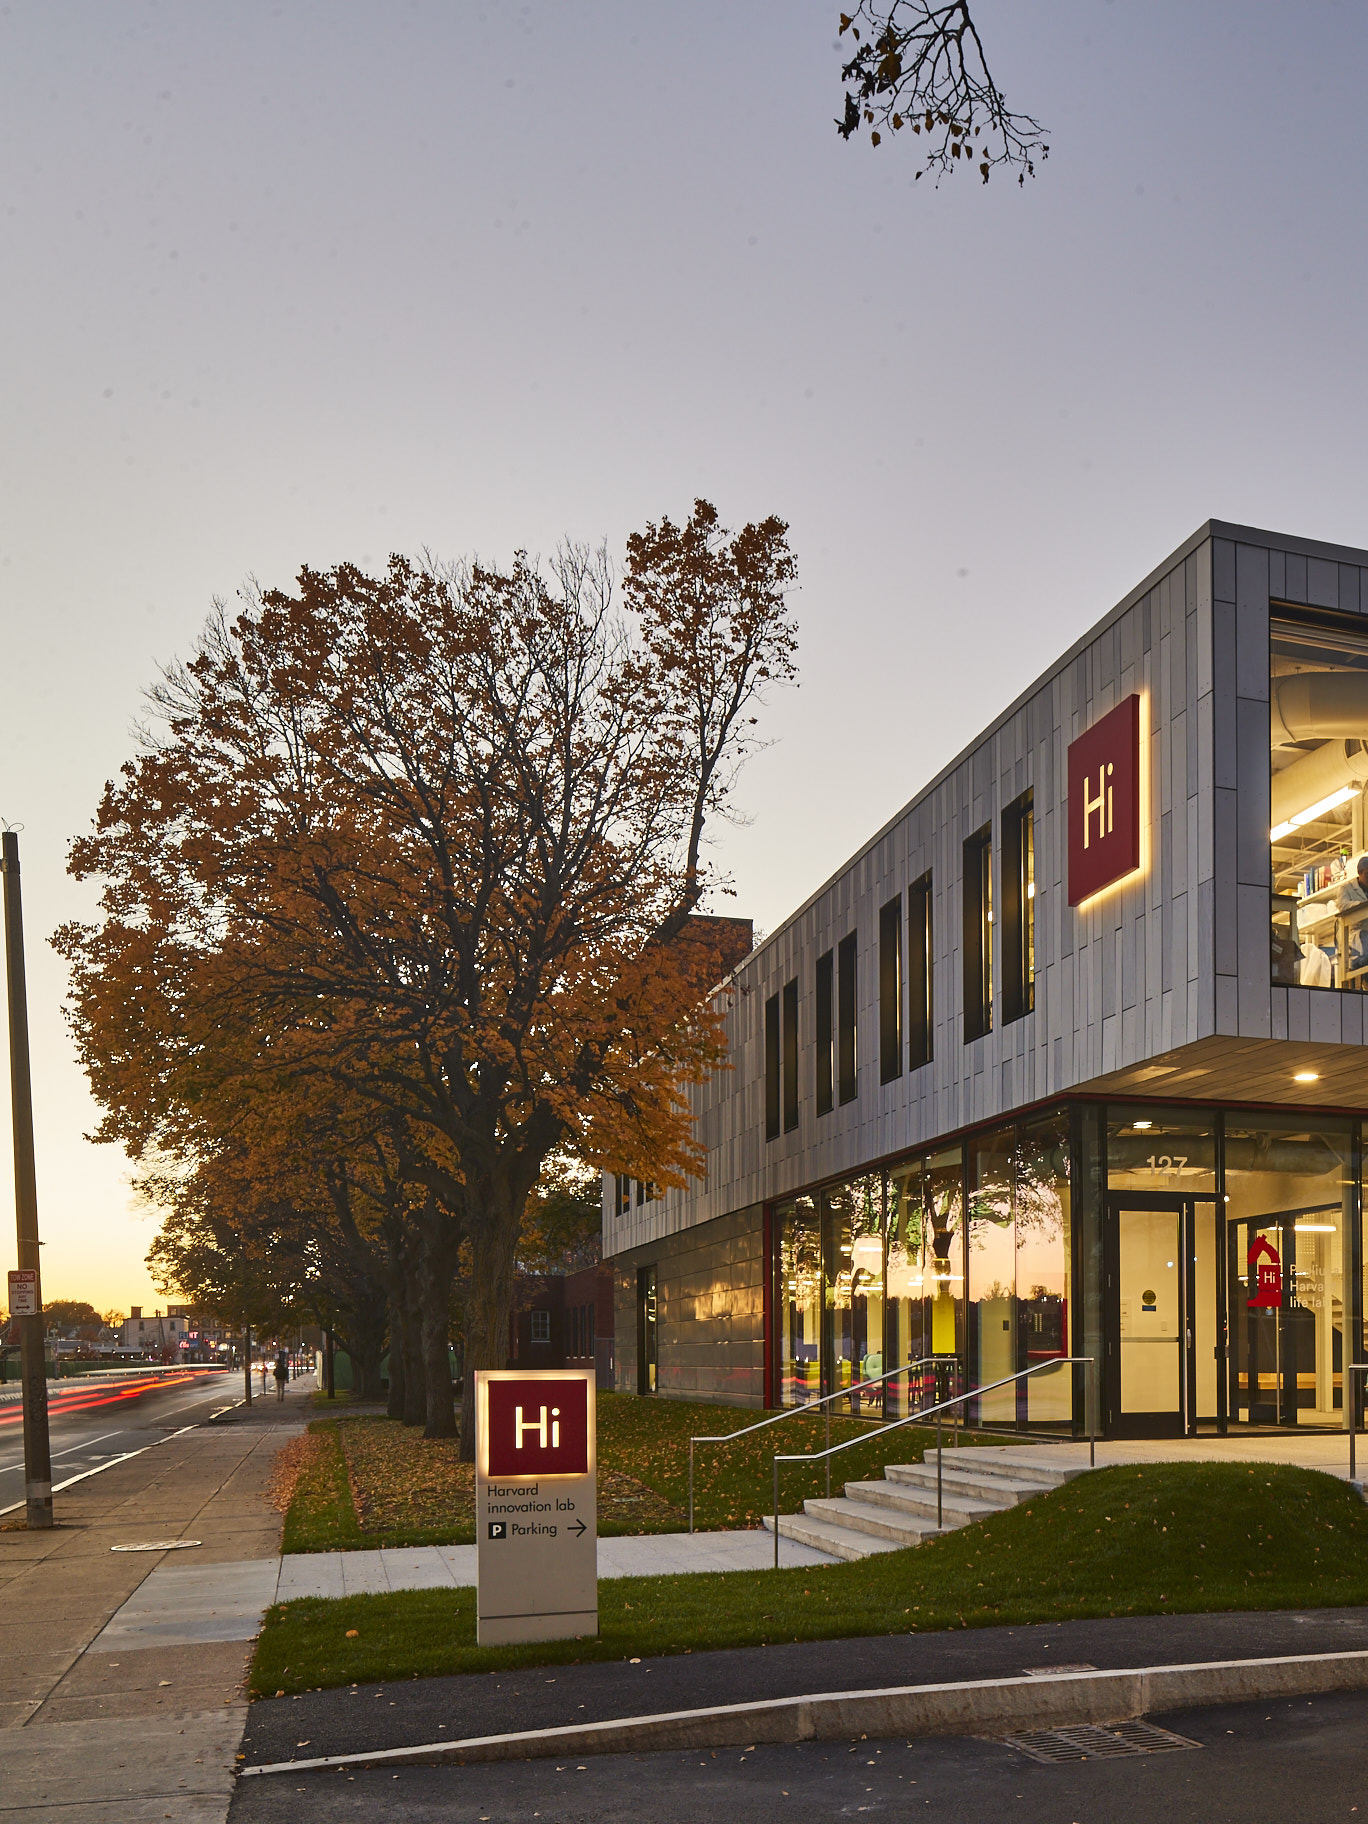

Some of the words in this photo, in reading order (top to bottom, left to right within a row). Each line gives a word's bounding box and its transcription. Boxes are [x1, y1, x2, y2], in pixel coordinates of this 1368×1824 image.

[1083, 762, 1114, 850] Hi
[1146, 1155, 1188, 1178] 127
[1264, 1271, 1276, 1284] Hi
[1289, 1280, 1332, 1292] Harva
[1289, 1295, 1309, 1308] life
[515, 1405, 560, 1449] Hi
[487, 1483, 539, 1497] Harvard
[487, 1500, 552, 1514] innovation
[556, 1498, 575, 1511] lab
[511, 1522, 557, 1538] Parking
